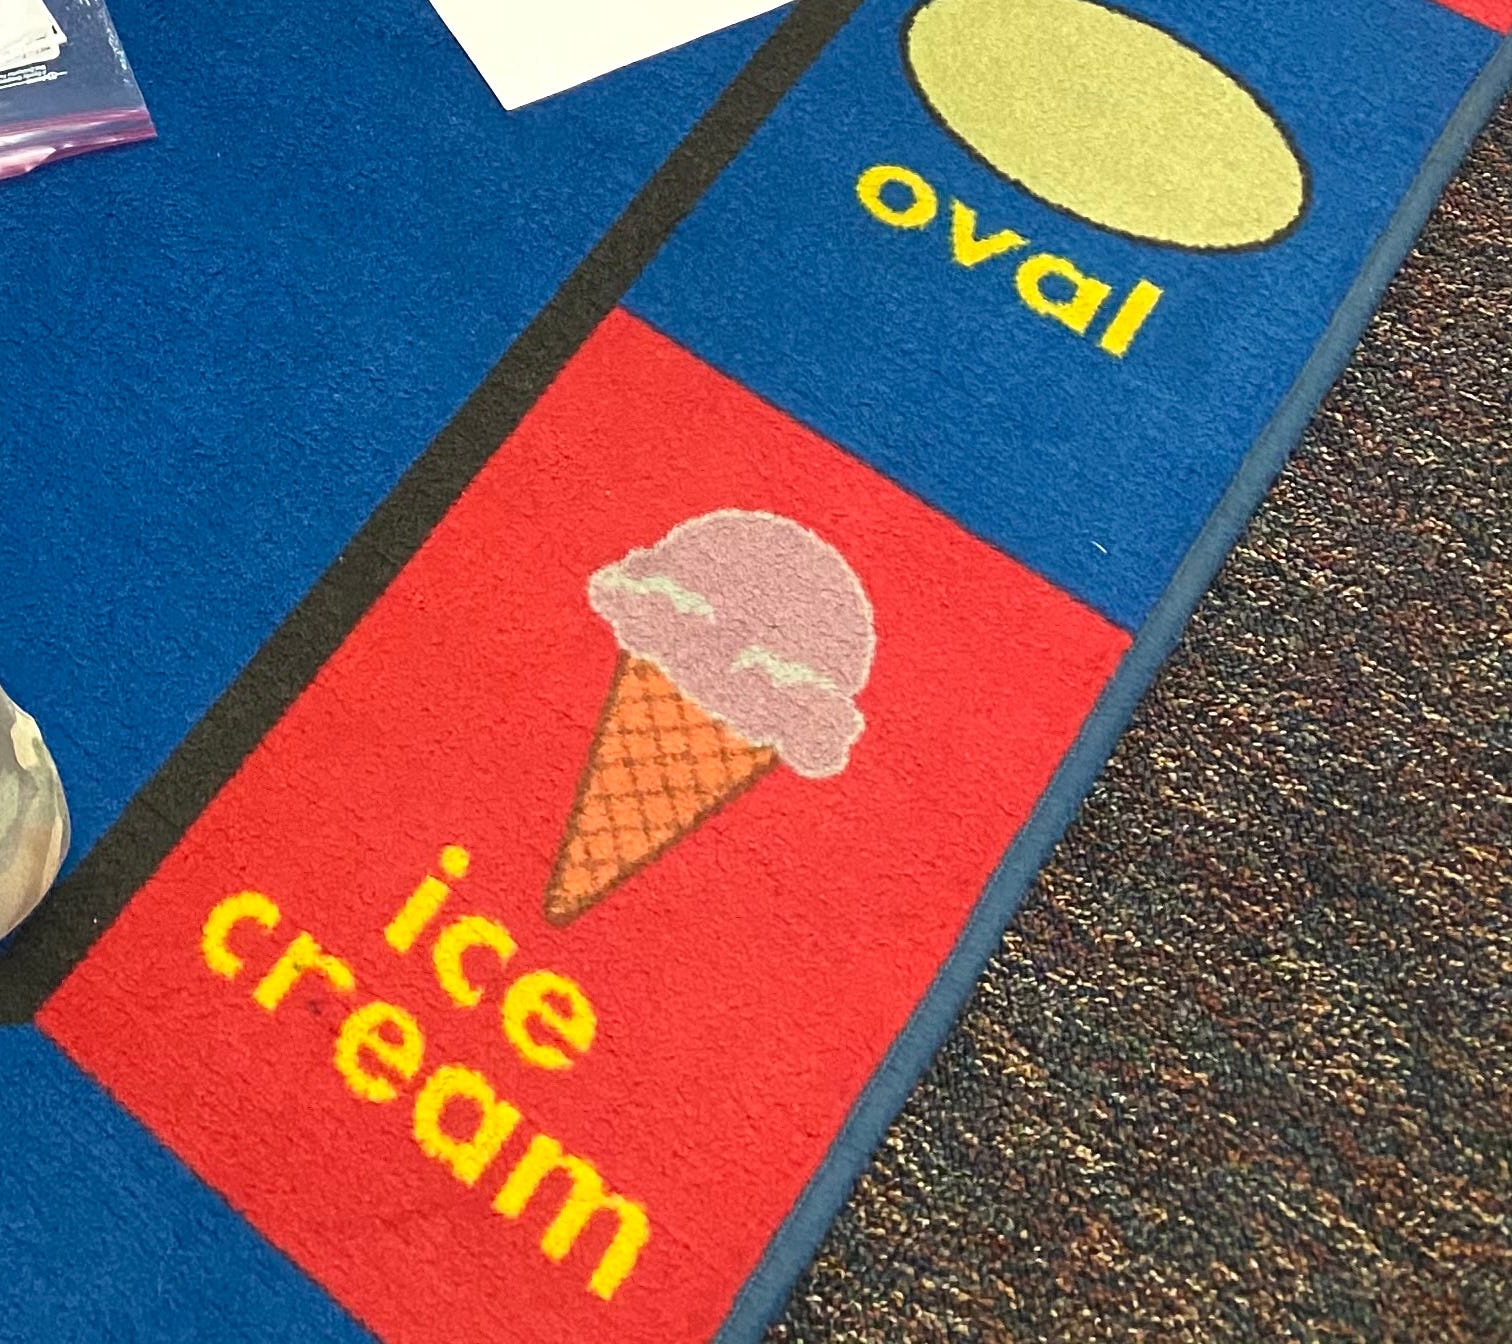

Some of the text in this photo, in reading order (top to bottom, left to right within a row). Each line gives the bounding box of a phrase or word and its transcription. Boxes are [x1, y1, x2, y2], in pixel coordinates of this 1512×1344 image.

[855, 162, 1164, 358] oval
[384, 844, 597, 1071] ice
[200, 889, 652, 1302] cream
